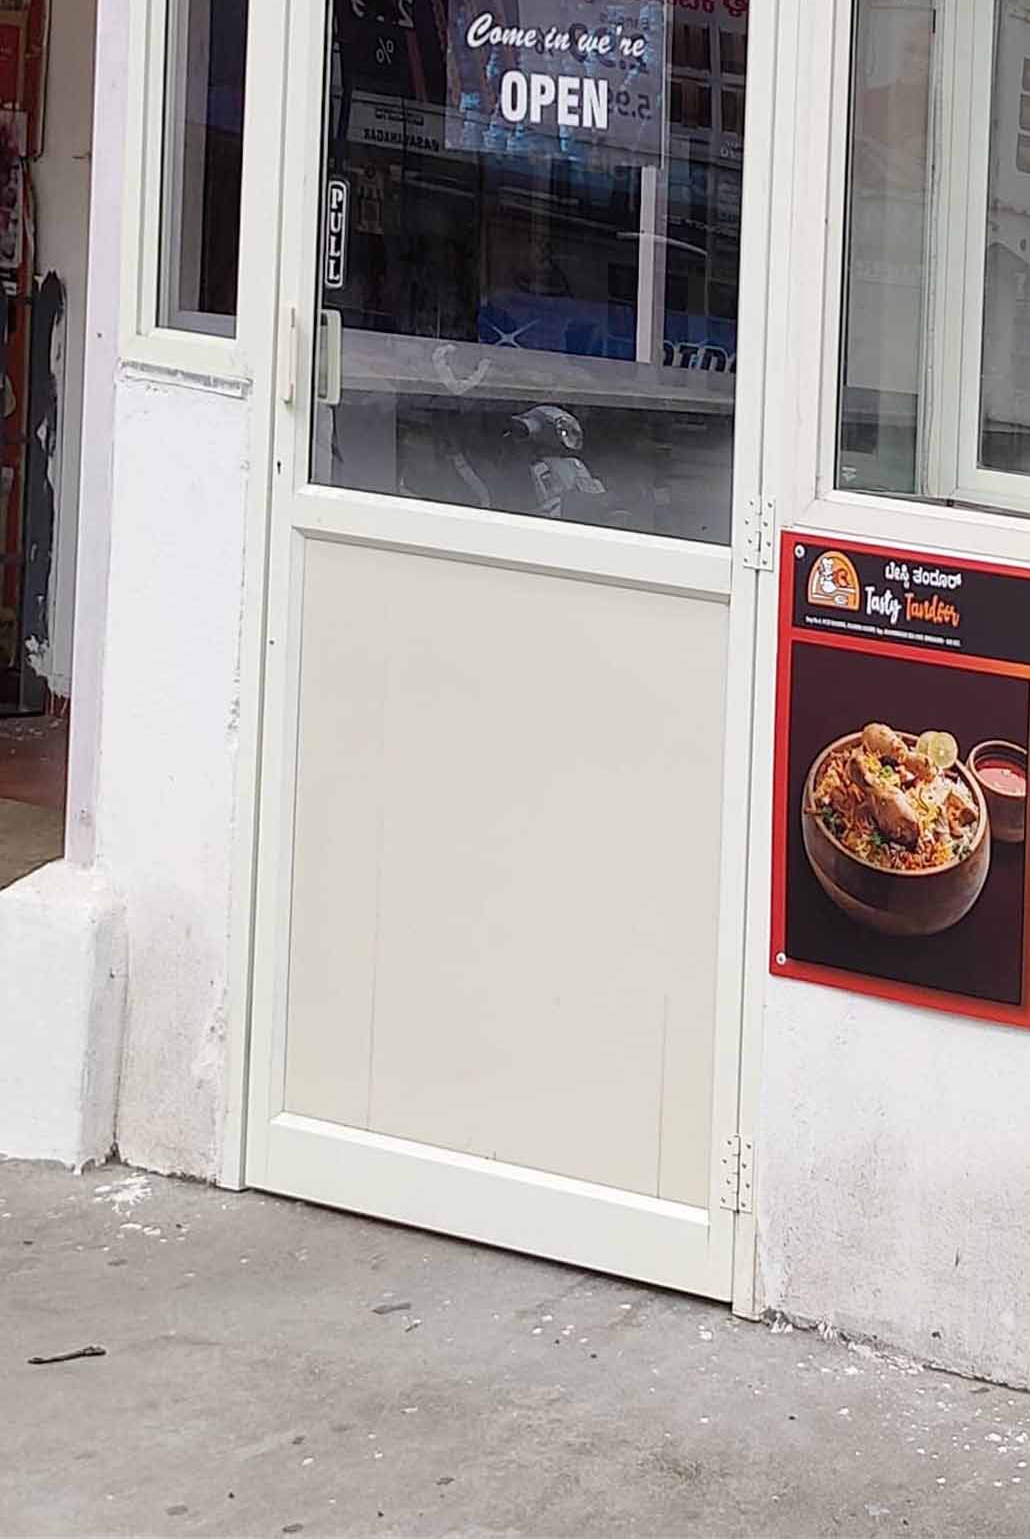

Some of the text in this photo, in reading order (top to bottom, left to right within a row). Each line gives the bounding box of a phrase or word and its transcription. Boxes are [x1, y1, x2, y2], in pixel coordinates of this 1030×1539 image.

[467, 13, 646, 57] Come in we're
[501, 70, 608, 130] OPEN
[329, 188, 343, 281] PULL
[865, 586, 902, 624] Tasty
[904, 592, 960, 627] Tandoor
